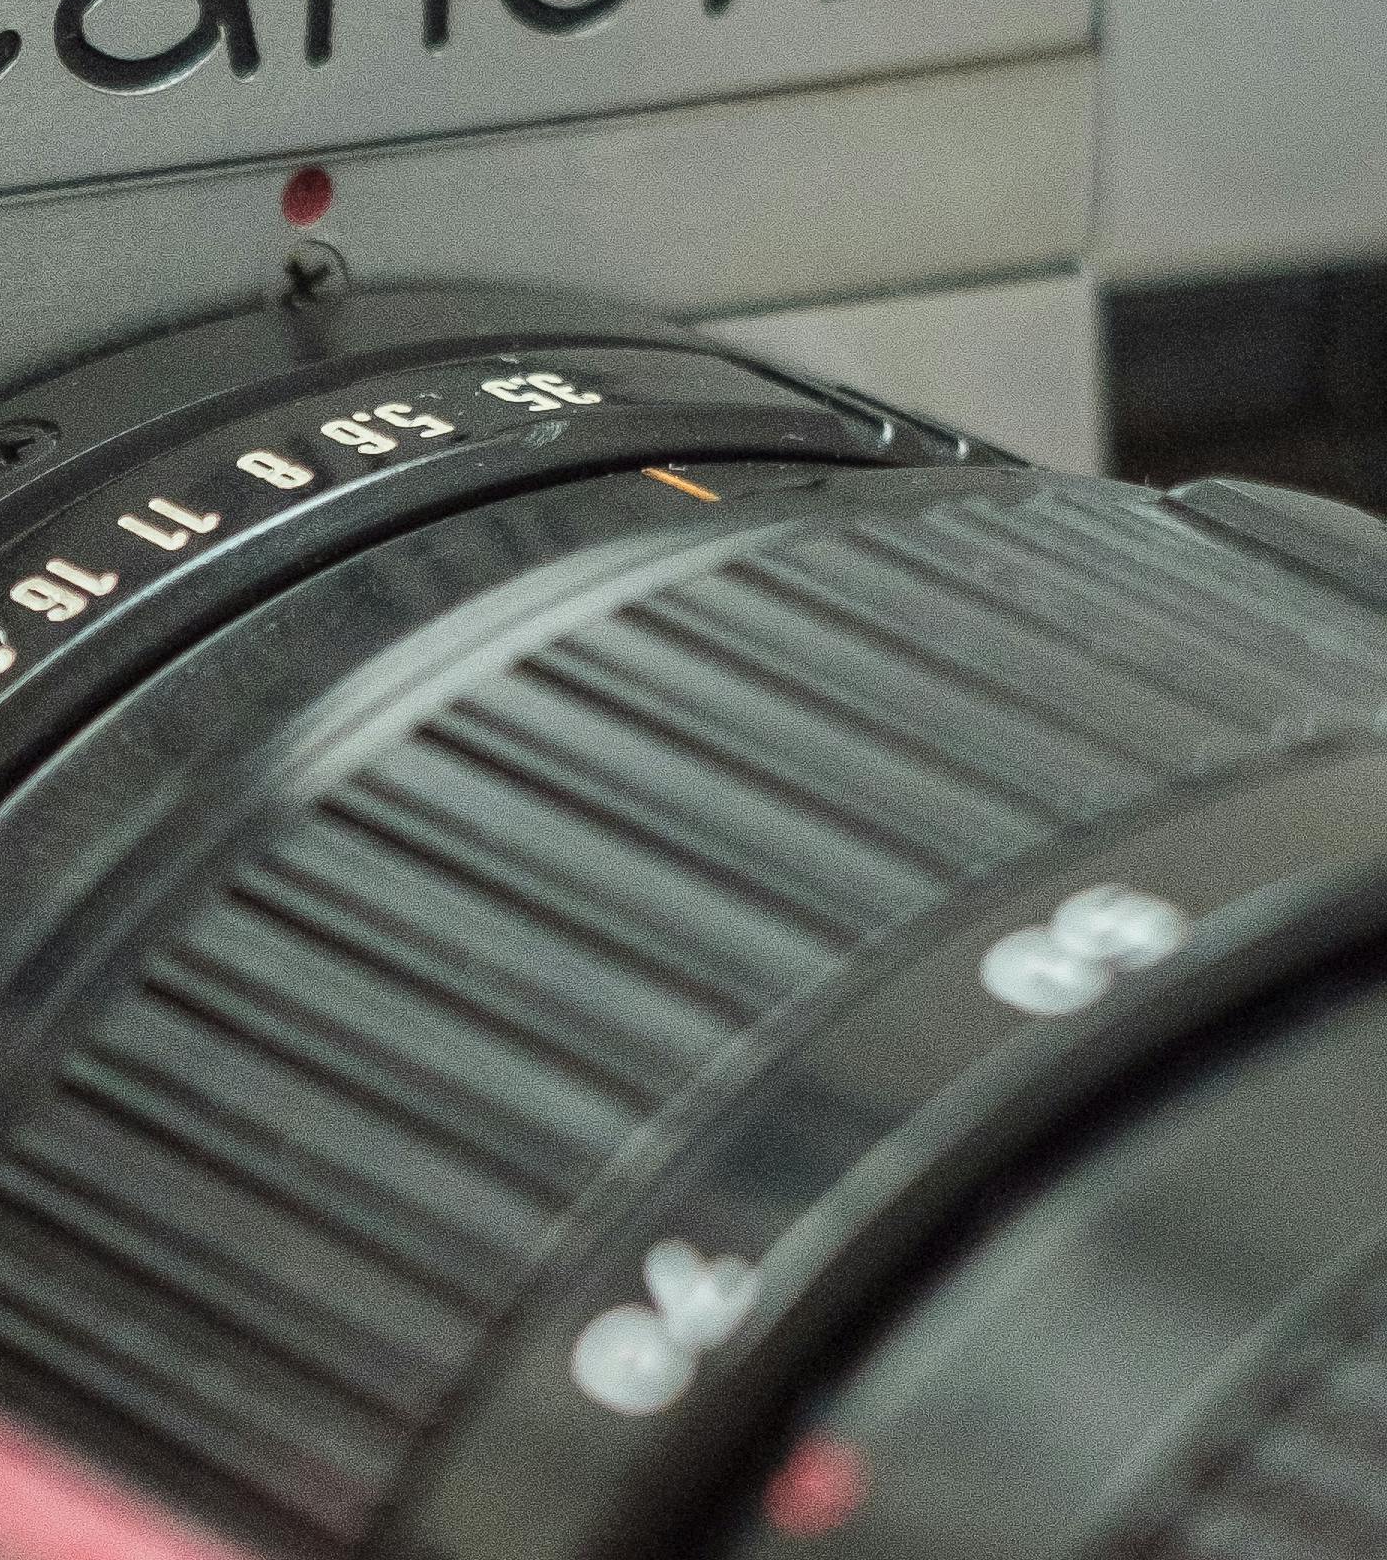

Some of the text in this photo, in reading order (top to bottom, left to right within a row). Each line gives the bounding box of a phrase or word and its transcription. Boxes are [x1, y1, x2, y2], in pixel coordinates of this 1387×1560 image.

[320, 401, 455, 456] 5.6
[235, 448, 315, 491] 8
[116, 495, 221, 553] 11
[9, 556, 120, 623] 16
